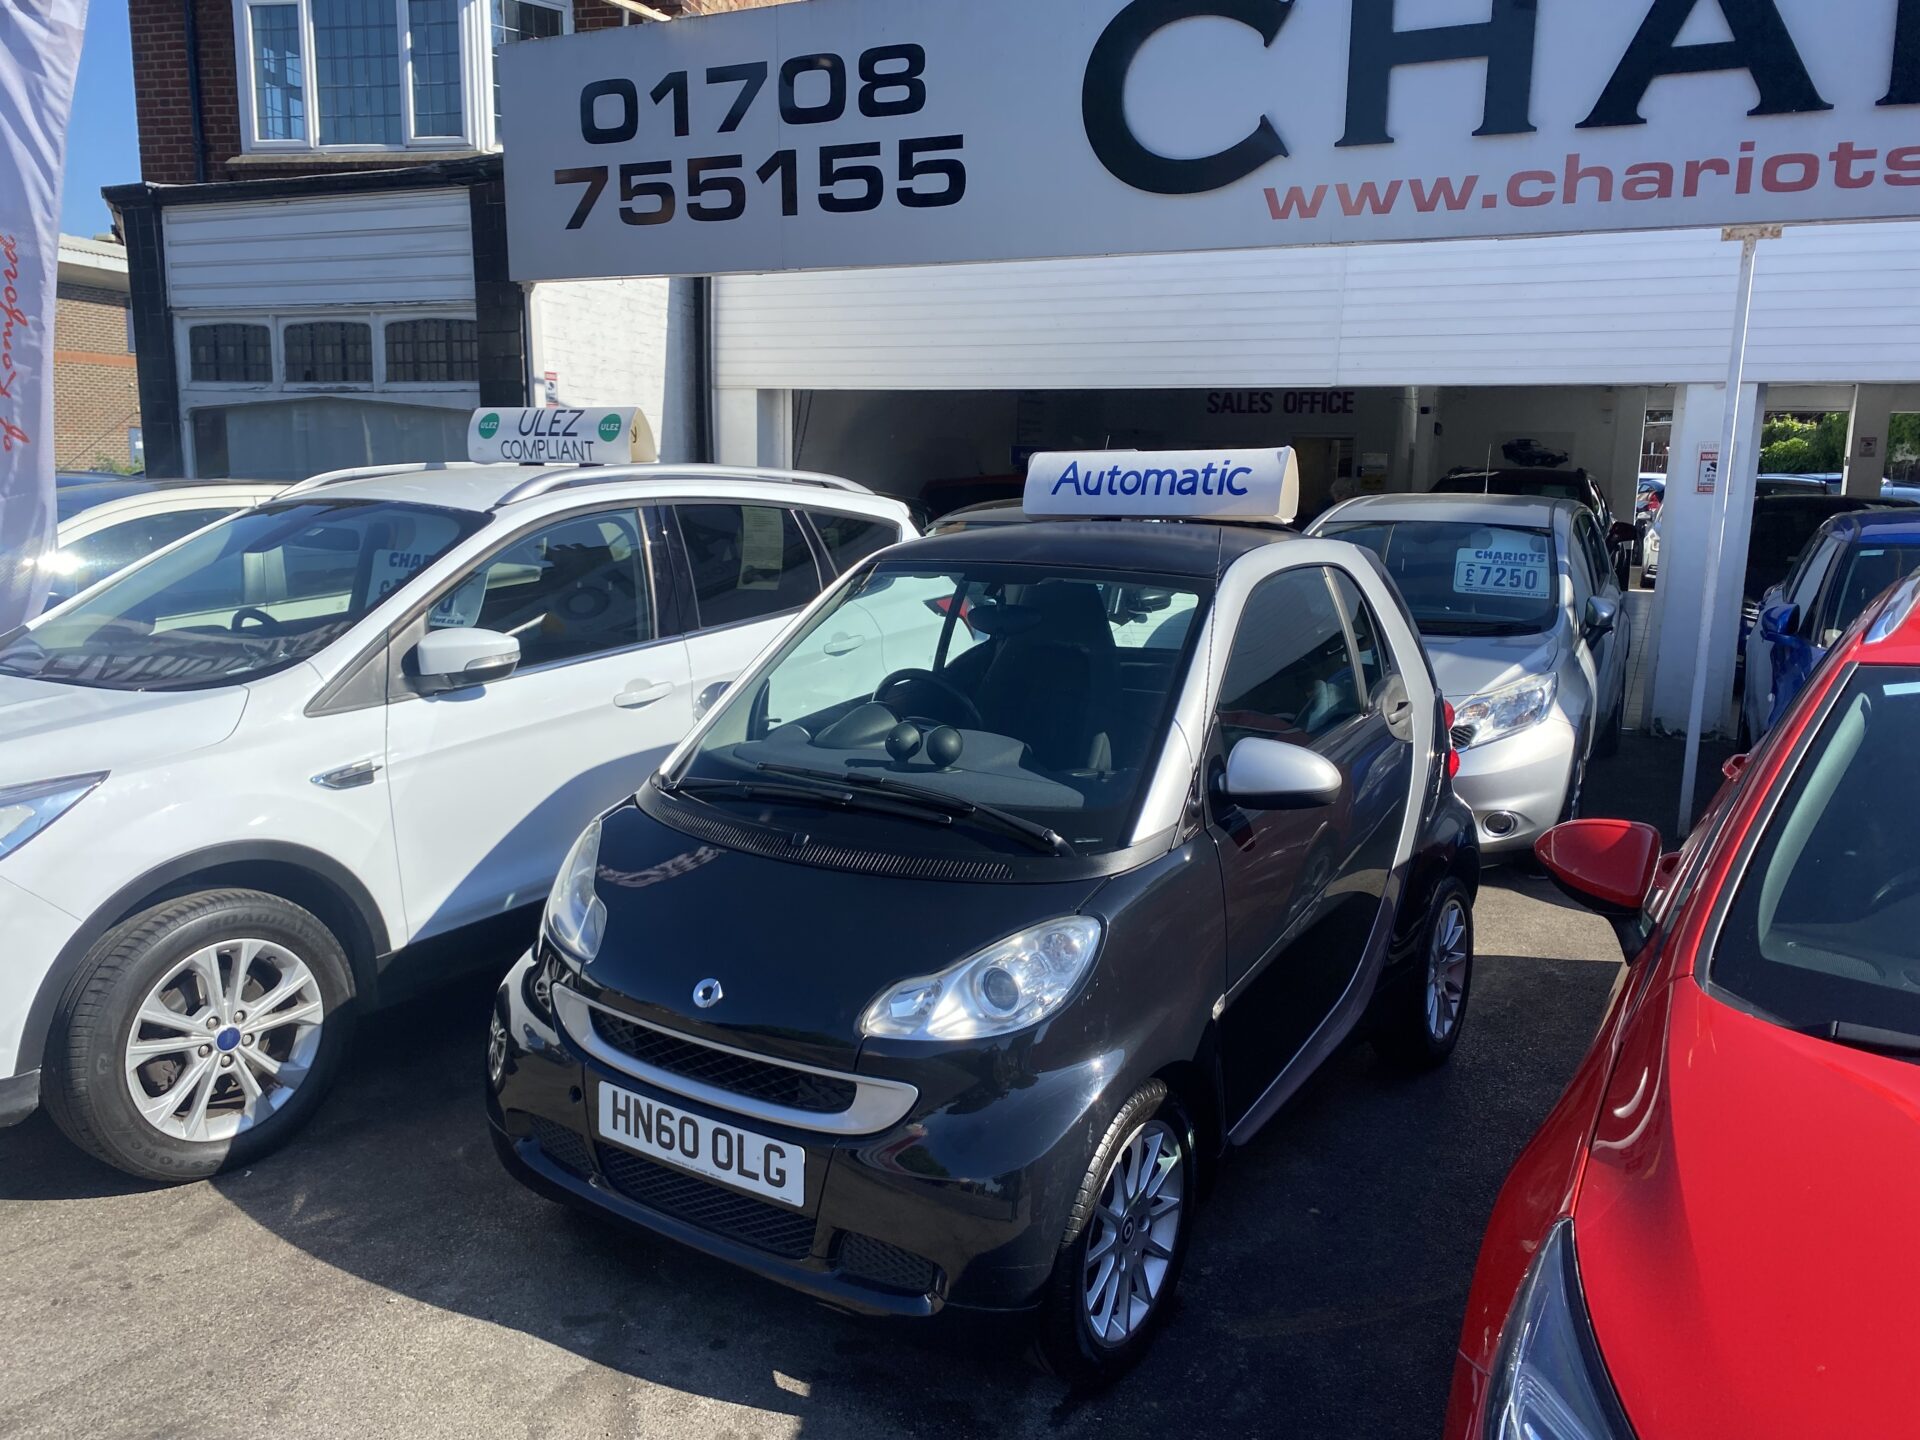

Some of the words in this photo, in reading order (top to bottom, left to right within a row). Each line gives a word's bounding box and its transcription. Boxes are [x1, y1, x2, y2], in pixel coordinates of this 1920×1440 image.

[580, 43, 926, 145] 01708
[554, 134, 966, 230] 755155
[1206, 391, 1273, 414] SALES
[1283, 390, 1355, 414] OFFICE
[480, 421, 498, 430] ULEZ
[518, 409, 585, 437] ULEZ
[600, 422, 620, 432] ULEZ
[500, 440, 594, 461] COMPLIANT
[1051, 460, 1252, 497] Automatic
[1475, 550, 1546, 563] CHARIOTS
[612, 1090, 700, 1160] HN60
[711, 1127, 786, 1188] OLG
